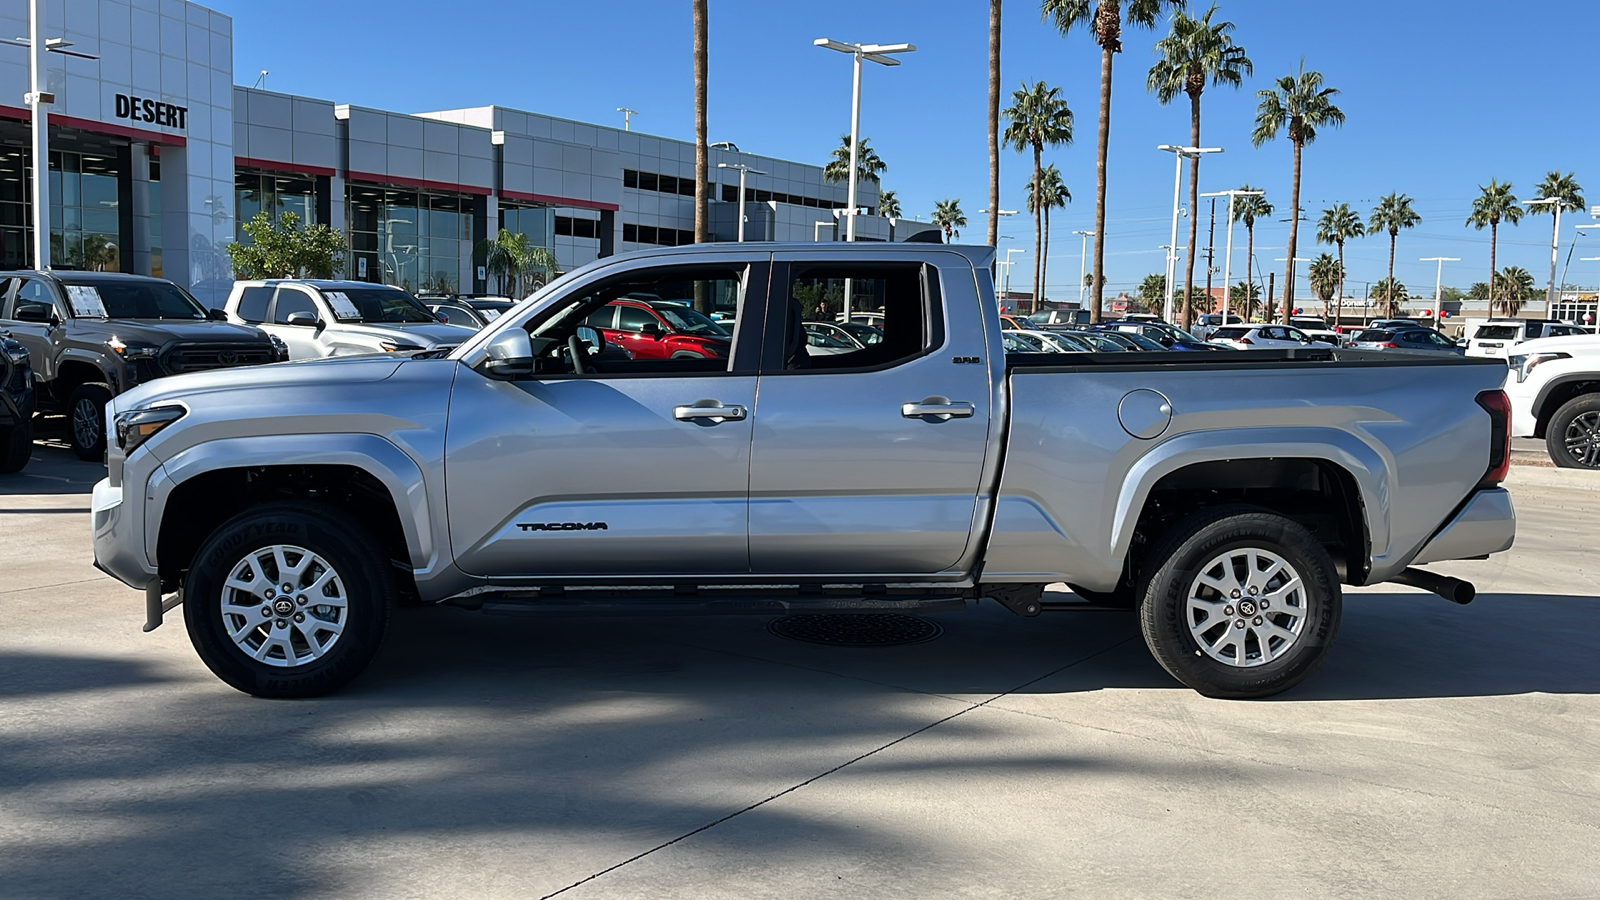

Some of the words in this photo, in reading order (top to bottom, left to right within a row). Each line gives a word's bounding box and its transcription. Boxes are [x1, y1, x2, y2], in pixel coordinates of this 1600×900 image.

[115, 93, 188, 129] DESERT
[1331, 298, 1375, 307] MDonald's
[516, 522, 608, 531] TACOMA
